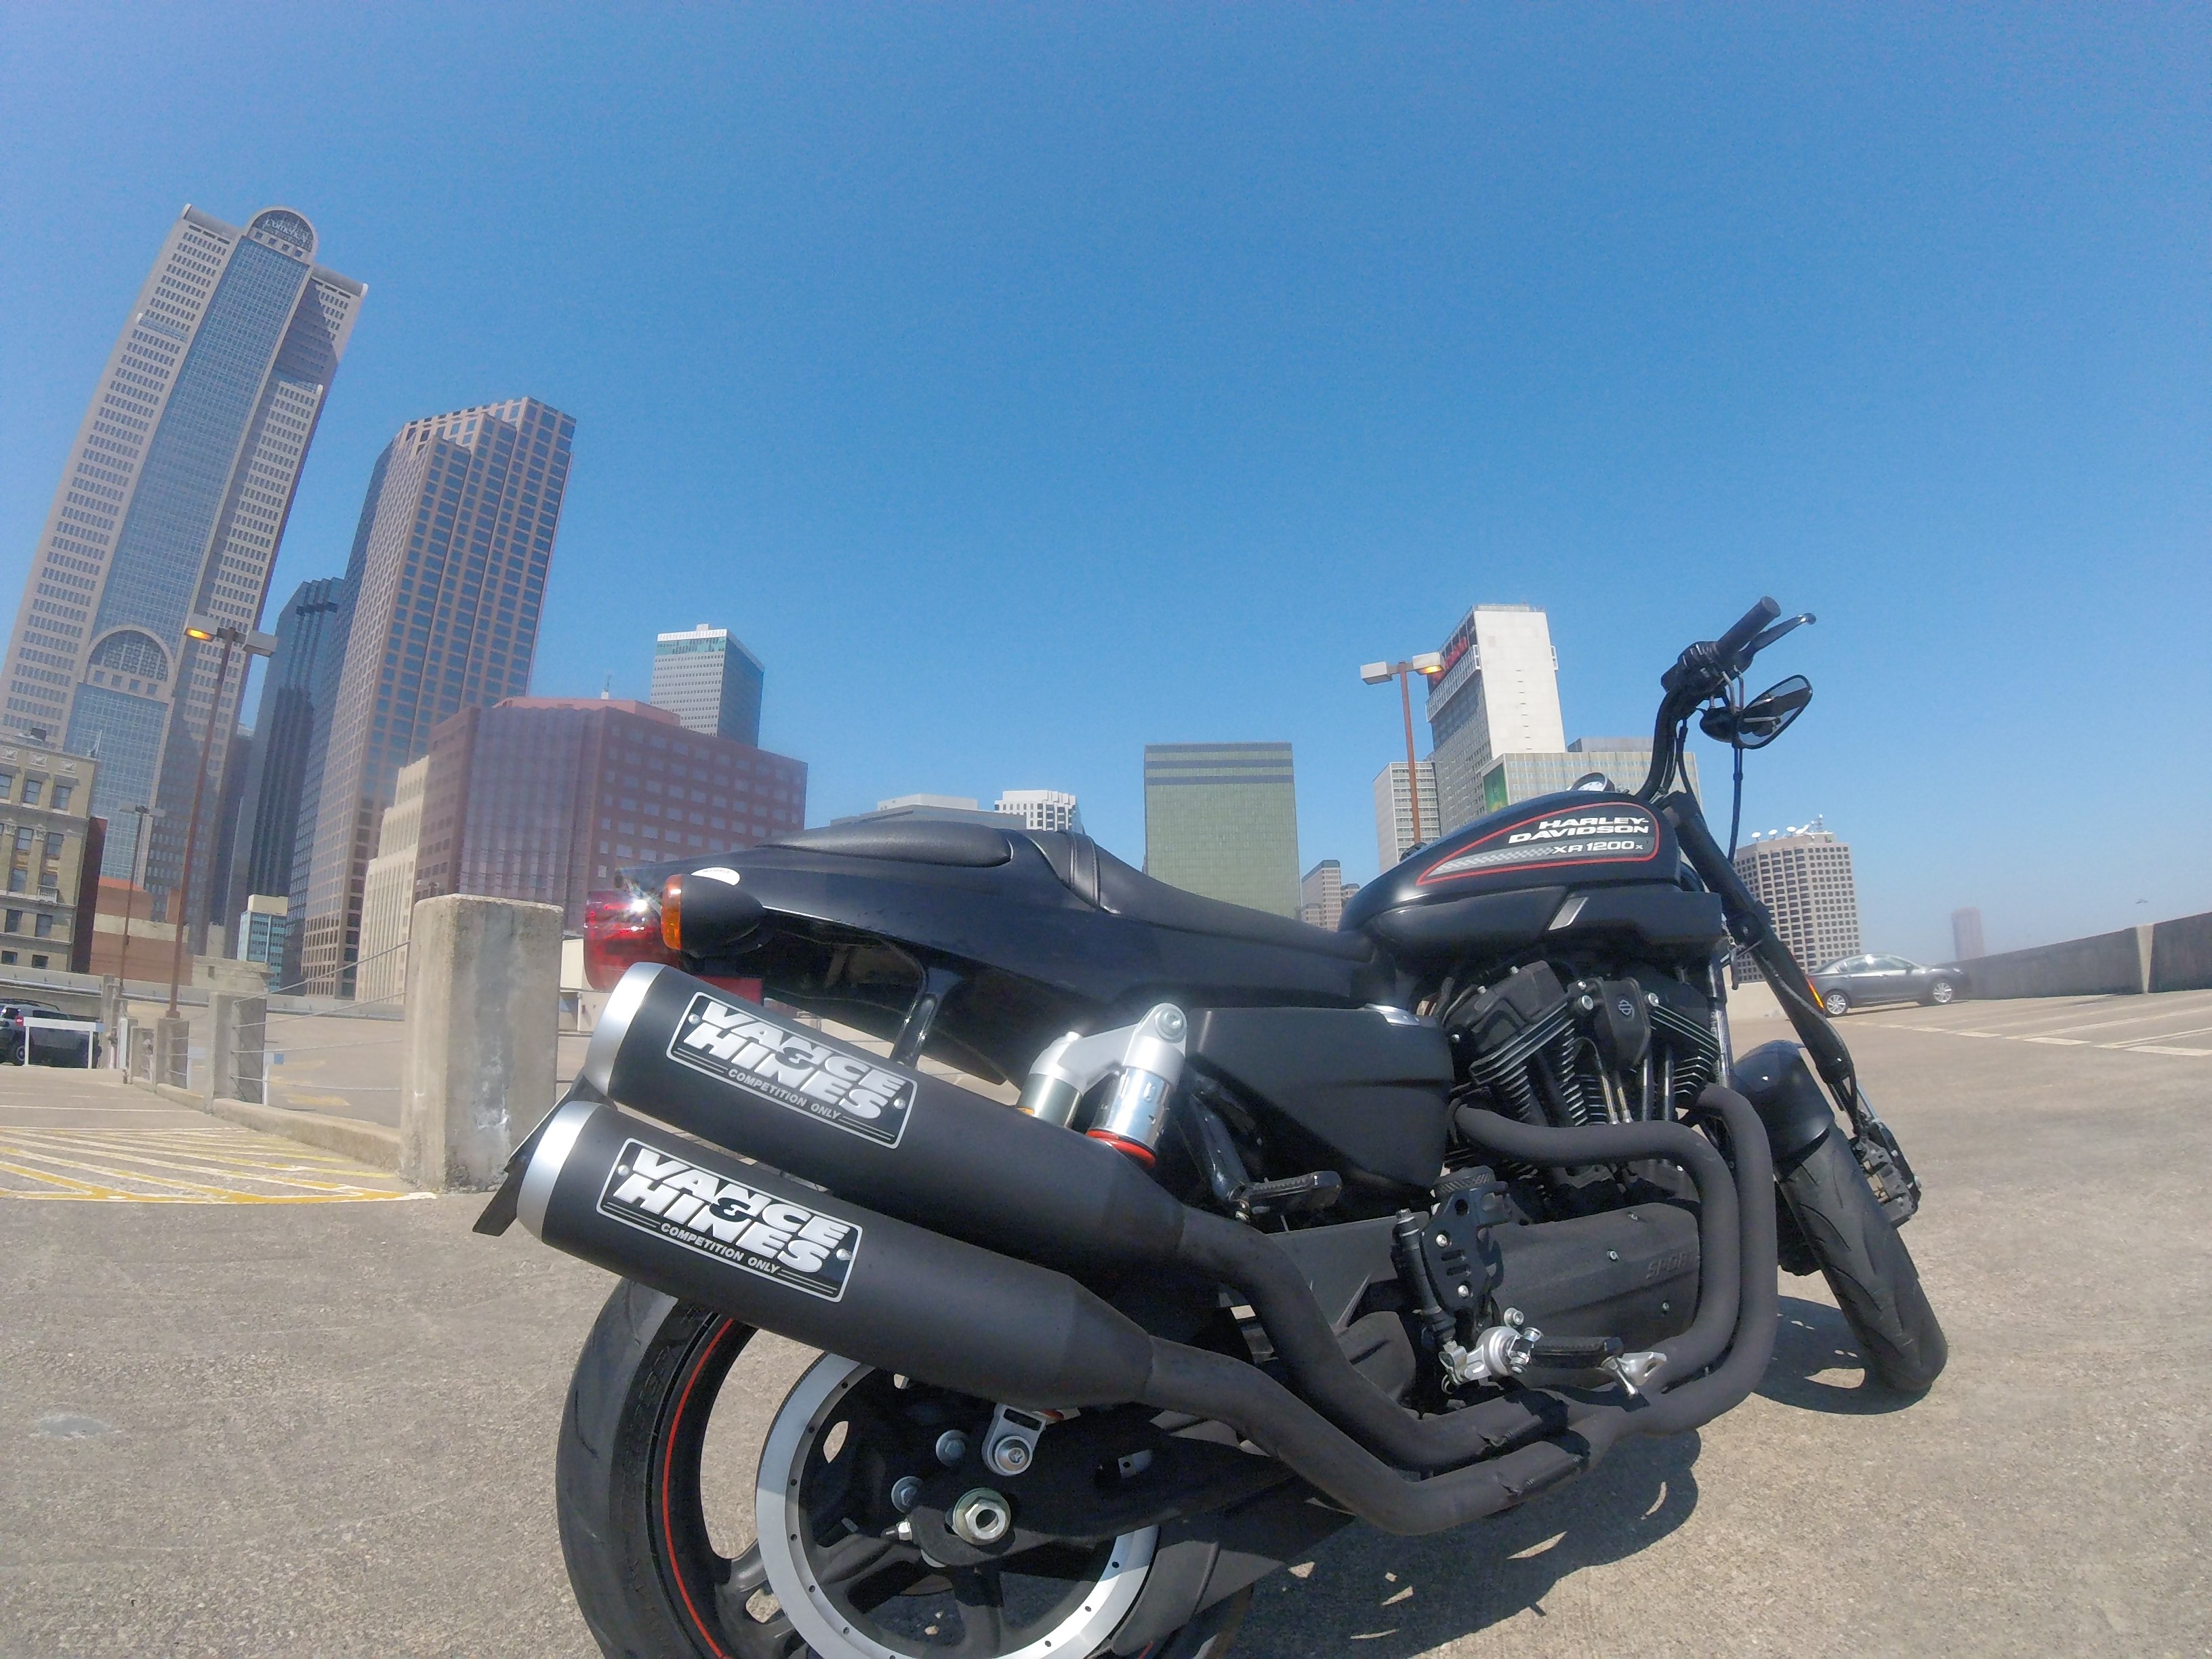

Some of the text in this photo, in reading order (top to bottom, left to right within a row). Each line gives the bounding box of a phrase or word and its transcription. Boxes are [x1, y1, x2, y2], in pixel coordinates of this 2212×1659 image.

[1509, 825, 1649, 844] DAVIDSON
[684, 1022, 888, 1119] HINES
[701, 1001, 906, 1098] VANCE
[728, 1068, 841, 1120] COMPETITION ONLY
[613, 1173, 830, 1273] HINES
[632, 1148, 851, 1249] VANCE
[661, 1223, 781, 1275] COMPETITION ONLY
